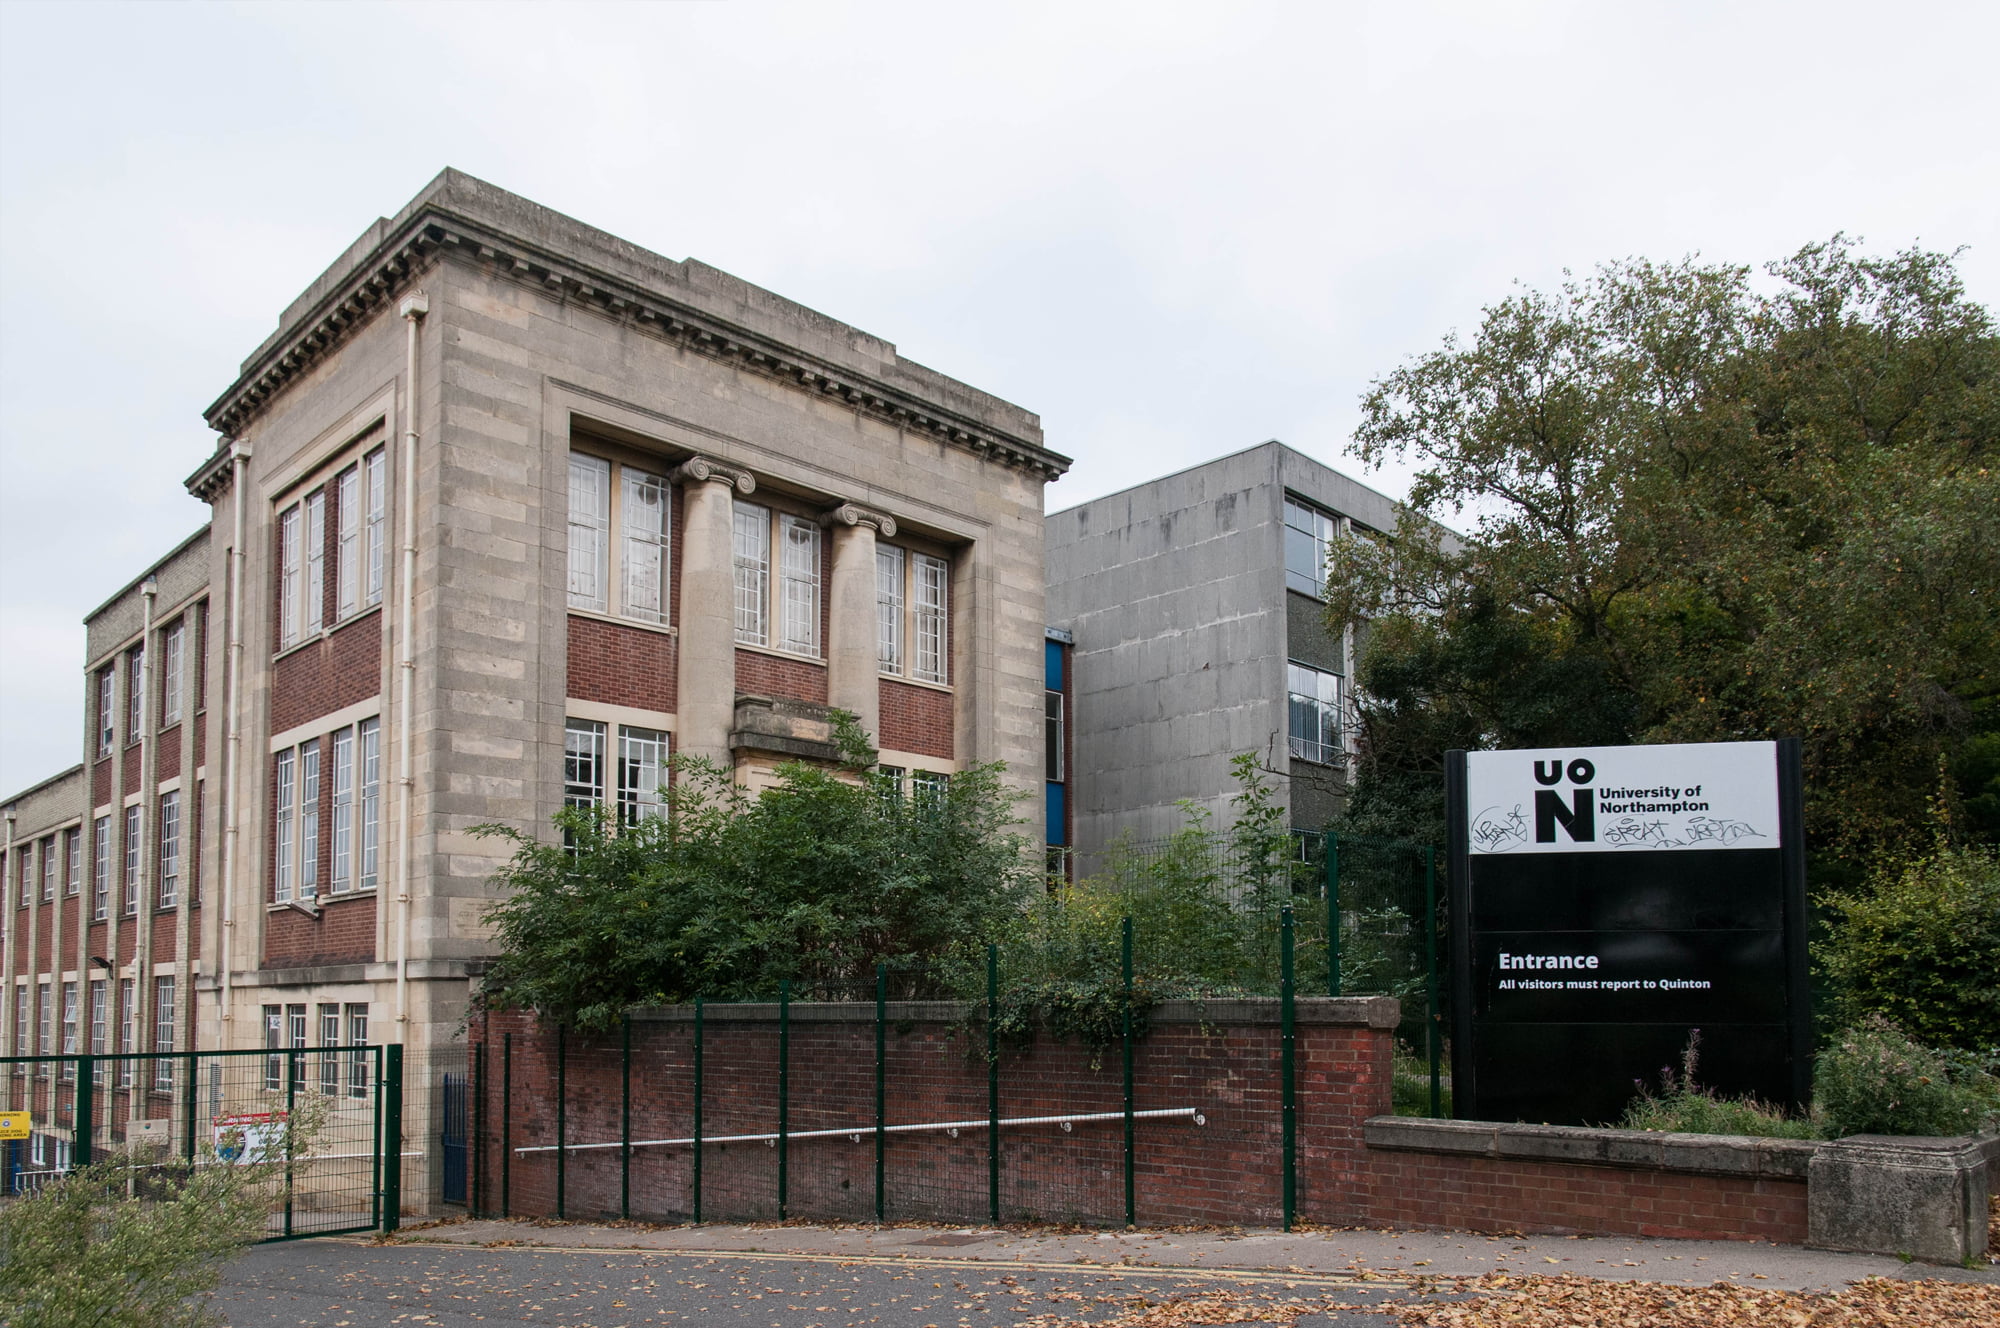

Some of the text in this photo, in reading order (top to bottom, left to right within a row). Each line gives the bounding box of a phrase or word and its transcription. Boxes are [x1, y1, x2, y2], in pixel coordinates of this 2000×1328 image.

[1600, 785, 1702, 800] University of
[1600, 802, 1710, 815] Northampton
[1499, 953, 1600, 969] Entrance
[1499, 979, 1711, 991] All visitors must report to Quinton
